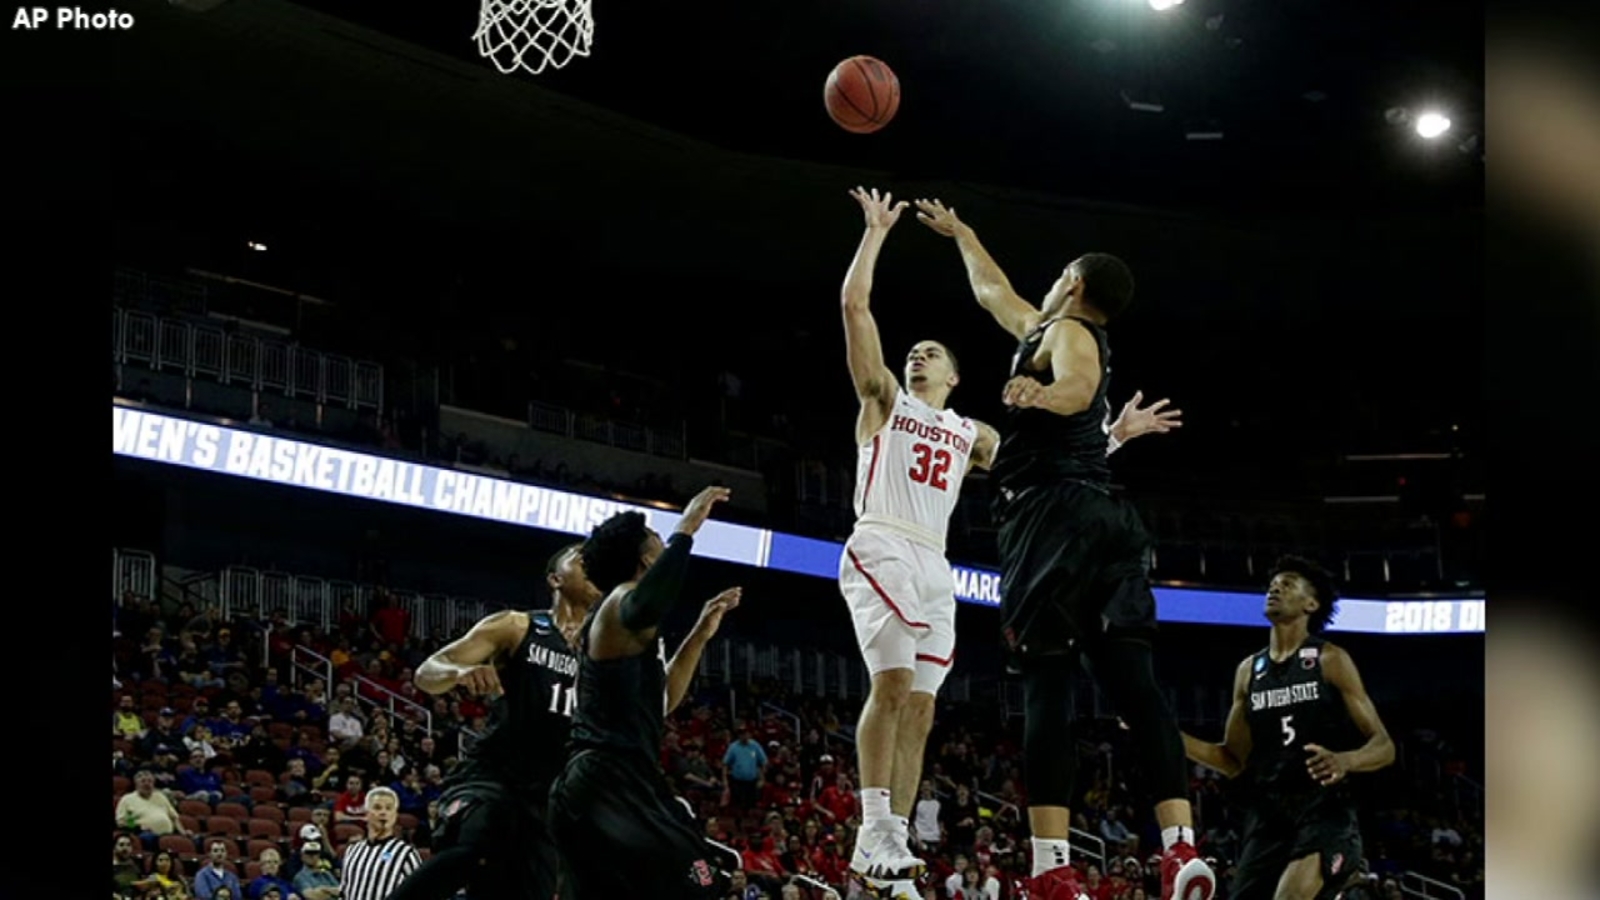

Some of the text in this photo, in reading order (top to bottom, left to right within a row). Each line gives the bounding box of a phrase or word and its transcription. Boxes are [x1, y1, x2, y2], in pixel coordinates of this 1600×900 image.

[890, 414, 970, 455] HOUSTON
[113, 407, 651, 533] MEN'S BASKETBALL CHAMPIONS
[908, 442, 953, 491] 32
[1385, 601, 1452, 632] 2018
[526, 643, 578, 677] SAN DIEGO
[548, 682, 573, 718] 11
[1251, 681, 1319, 712] SAN DIEGO STATE
[1281, 714, 1296, 746] 5
